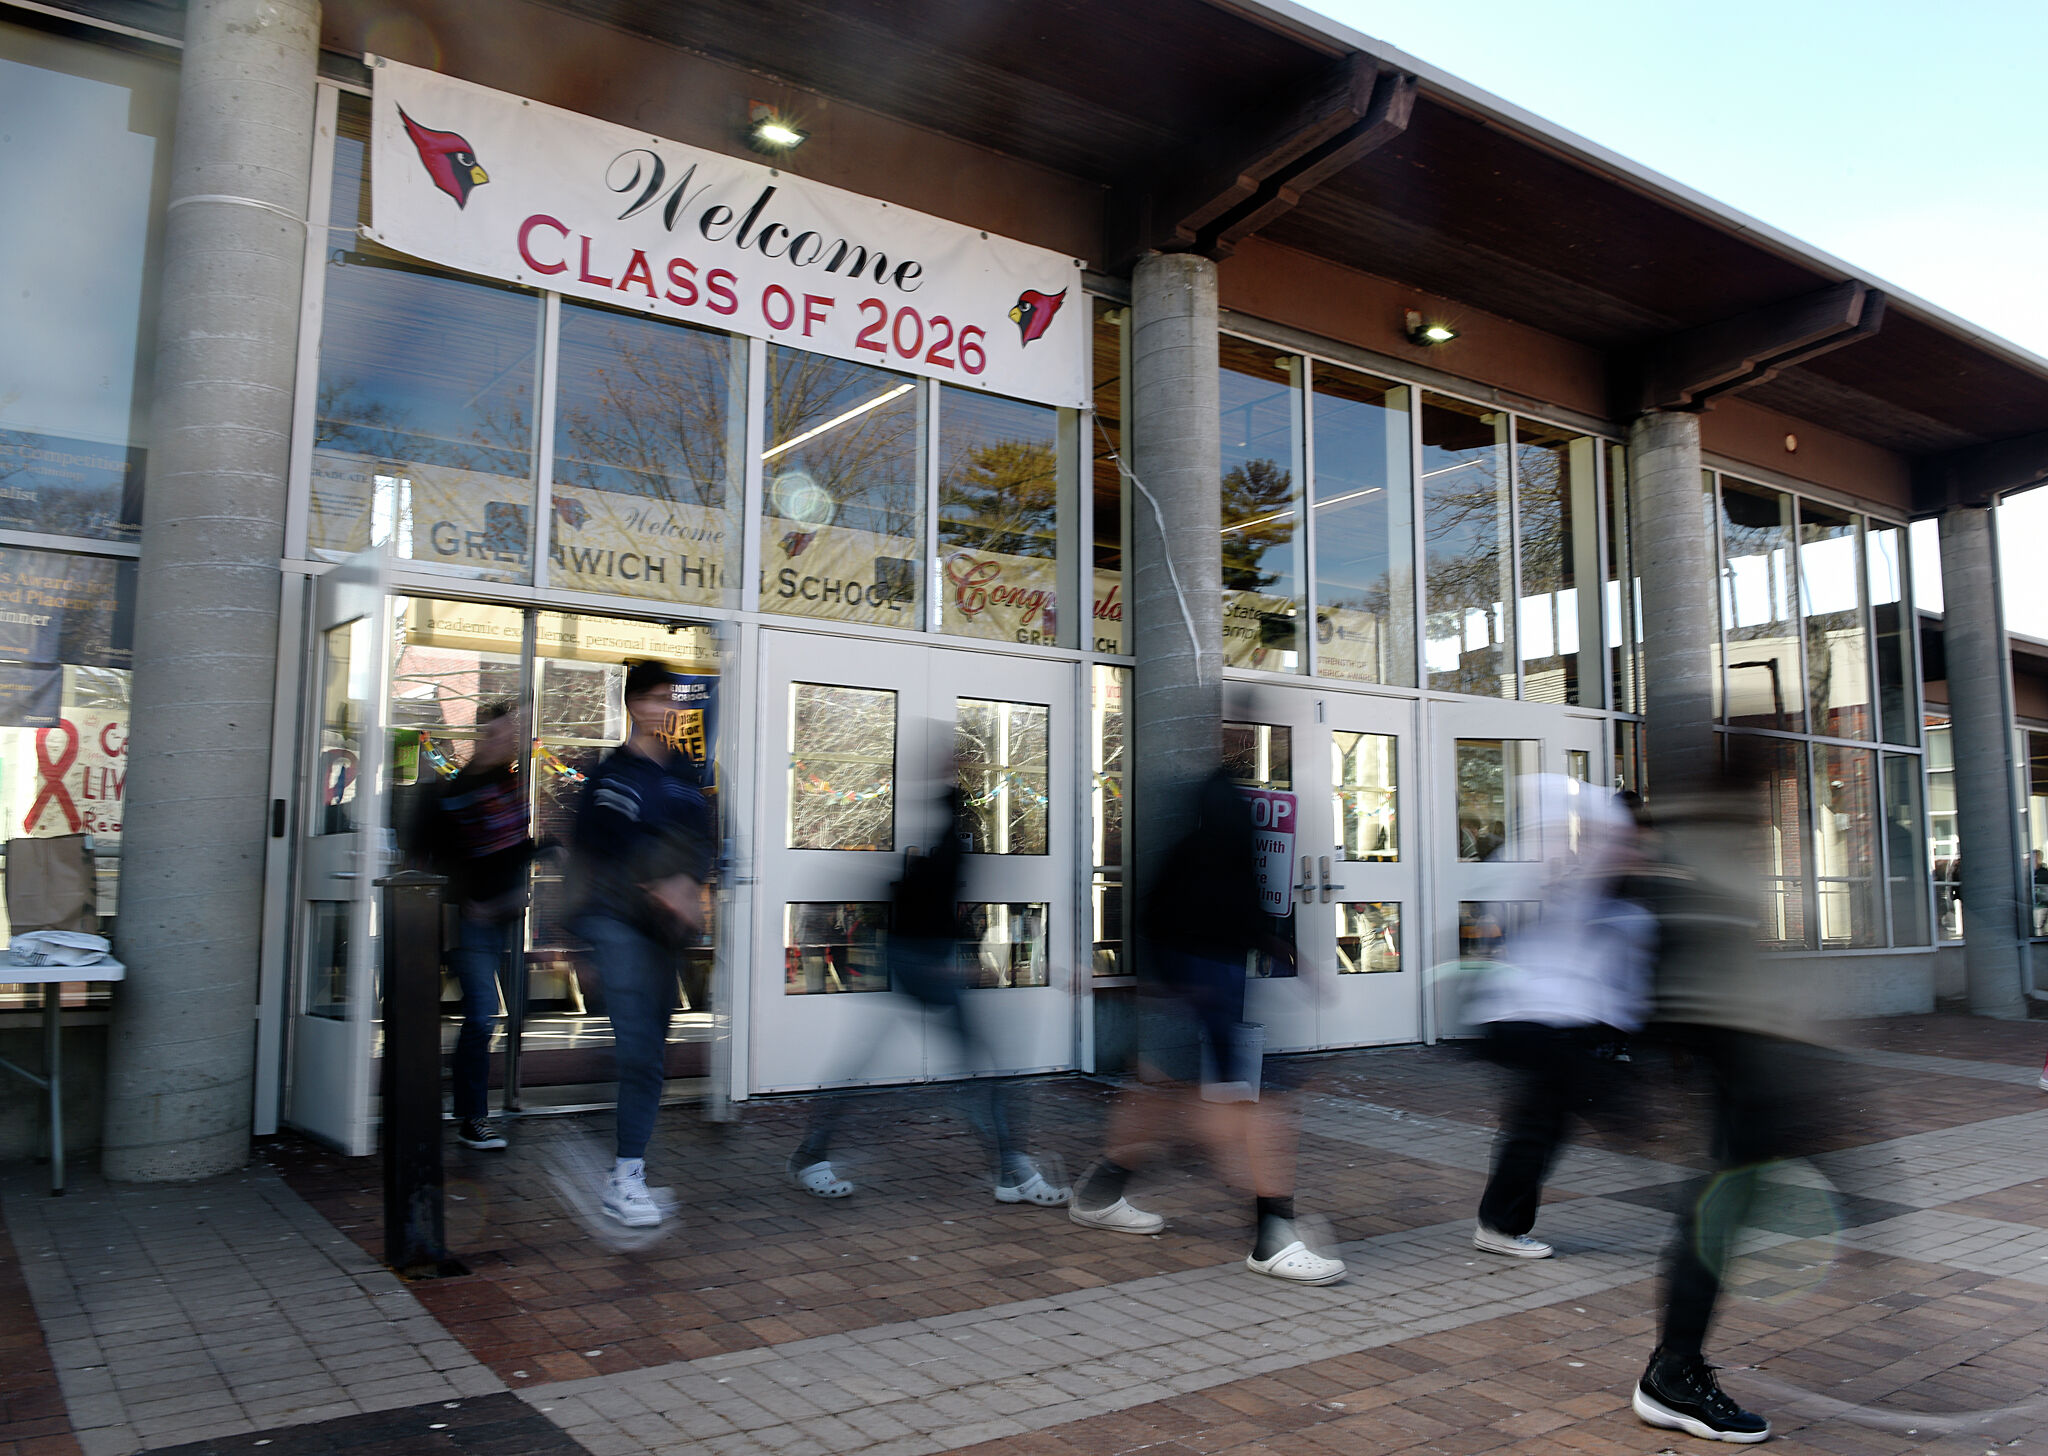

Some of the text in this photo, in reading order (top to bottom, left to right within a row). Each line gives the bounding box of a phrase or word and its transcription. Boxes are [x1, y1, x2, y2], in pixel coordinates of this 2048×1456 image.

[605, 149, 924, 292] Welcome
[517, 214, 986, 375] CLASS OF 2026
[623, 506, 726, 544] Welcome
[426, 617, 499, 635] academic
[586, 635, 645, 650] personal
[1316, 701, 1323, 723] 1
[1249, 797, 1293, 829] OP
[1255, 838, 1286, 854] With
